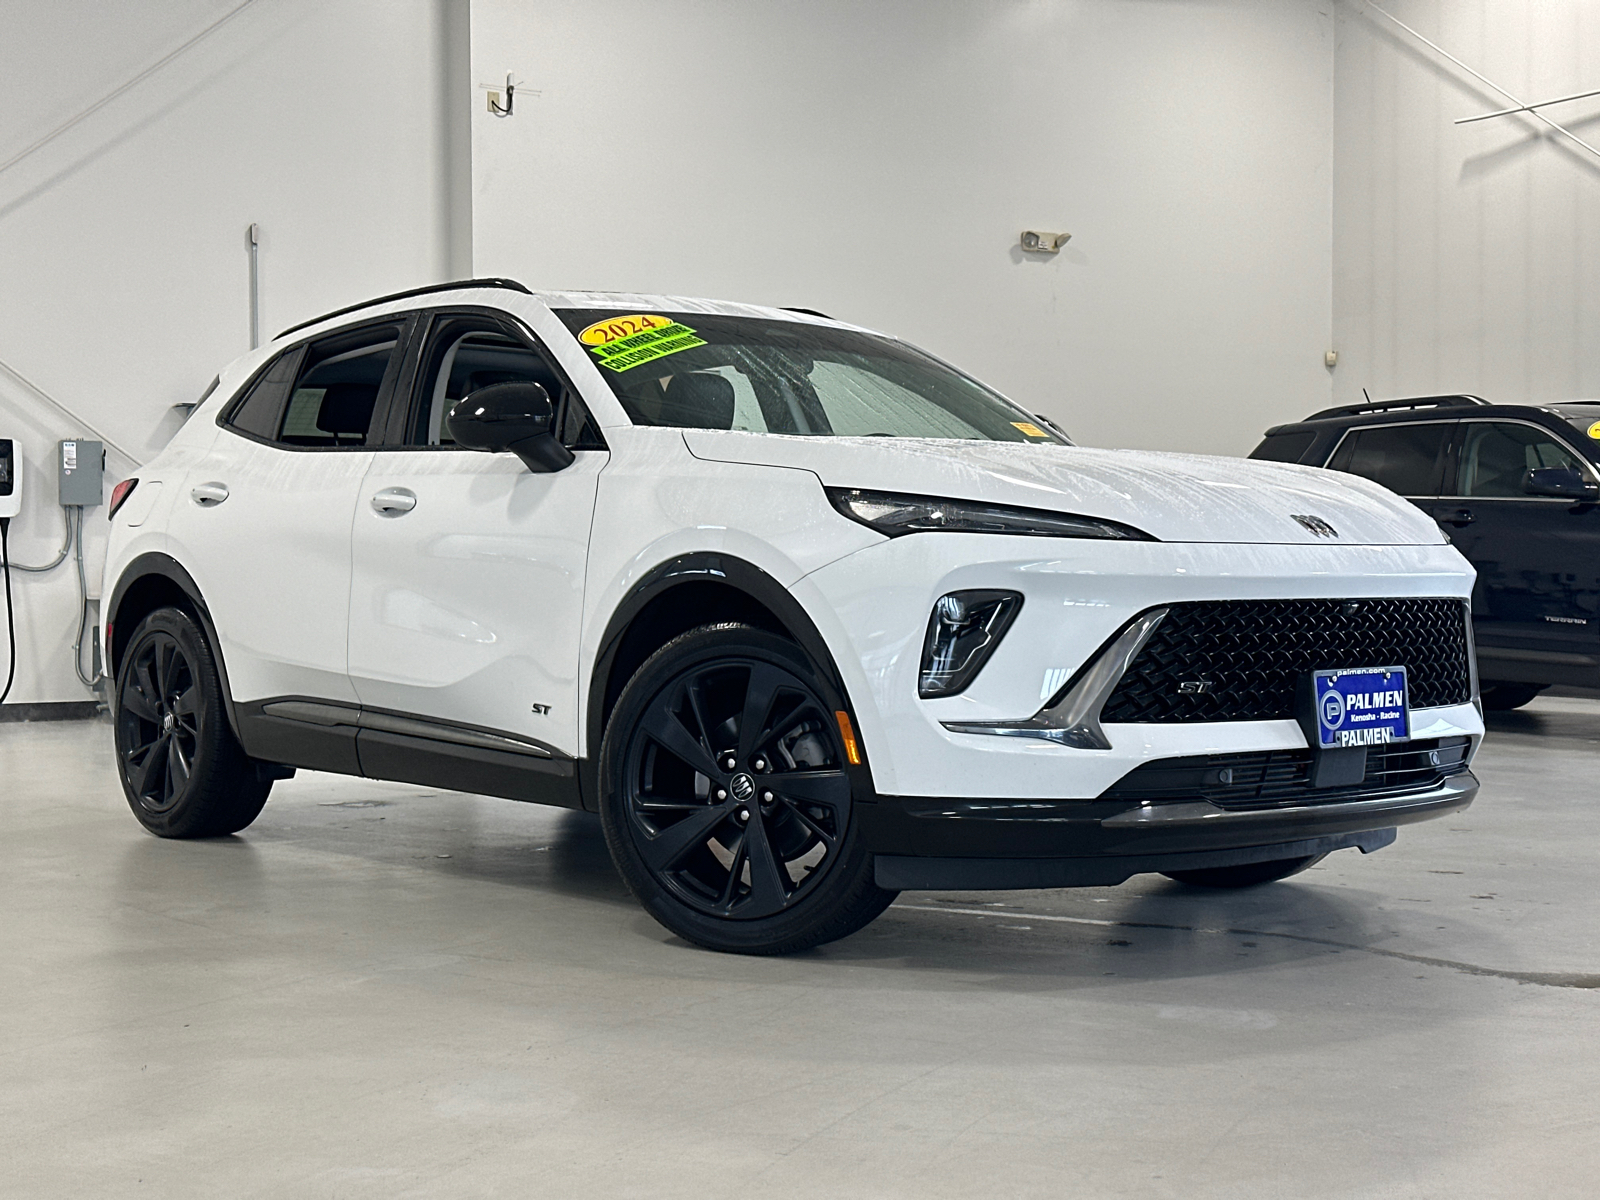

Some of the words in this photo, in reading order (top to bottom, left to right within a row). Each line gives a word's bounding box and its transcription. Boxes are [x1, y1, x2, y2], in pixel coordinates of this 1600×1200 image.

[594, 316, 656, 343] 2024
[601, 344, 629, 356] ALL
[619, 332, 663, 349] WHEEL
[604, 347, 660, 370] COLLISION
[1337, 667, 1386, 677] palmen.com
[1178, 681, 1212, 693] ST
[531, 702, 552, 716] ST
[1346, 690, 1403, 711] PALMEN
[1326, 702, 1341, 720] P
[1350, 712, 1376, 722] Kenosha
[1380, 711, 1400, 720] Racine
[1341, 727, 1391, 747] PALMEN
